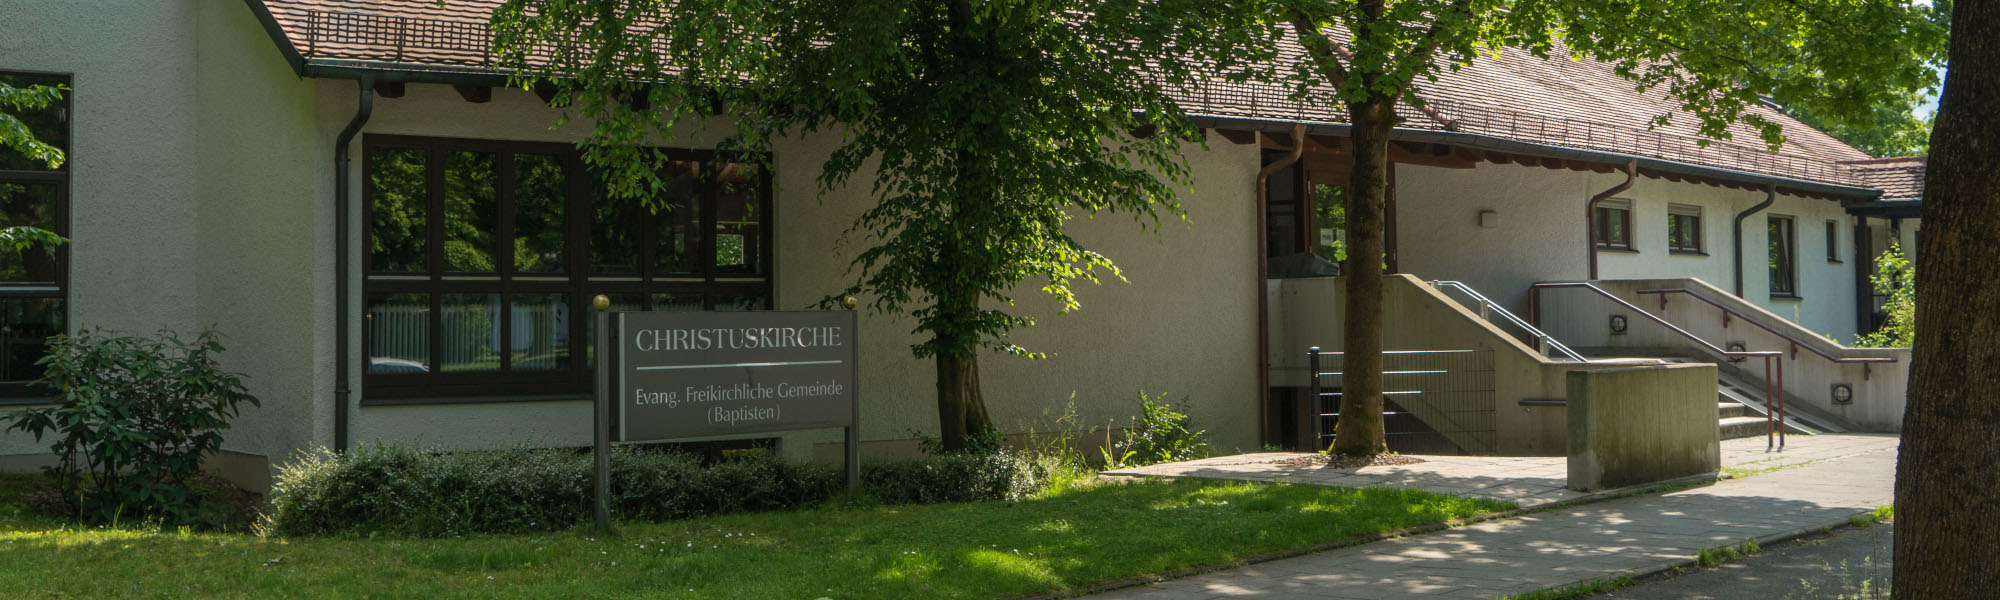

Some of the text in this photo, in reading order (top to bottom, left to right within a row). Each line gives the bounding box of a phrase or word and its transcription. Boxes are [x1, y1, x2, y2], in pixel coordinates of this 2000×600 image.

[636, 326, 842, 352] CHRISTUSKIRCHE
[636, 379, 843, 409] Evang. Freikirchliche Gemeinde
